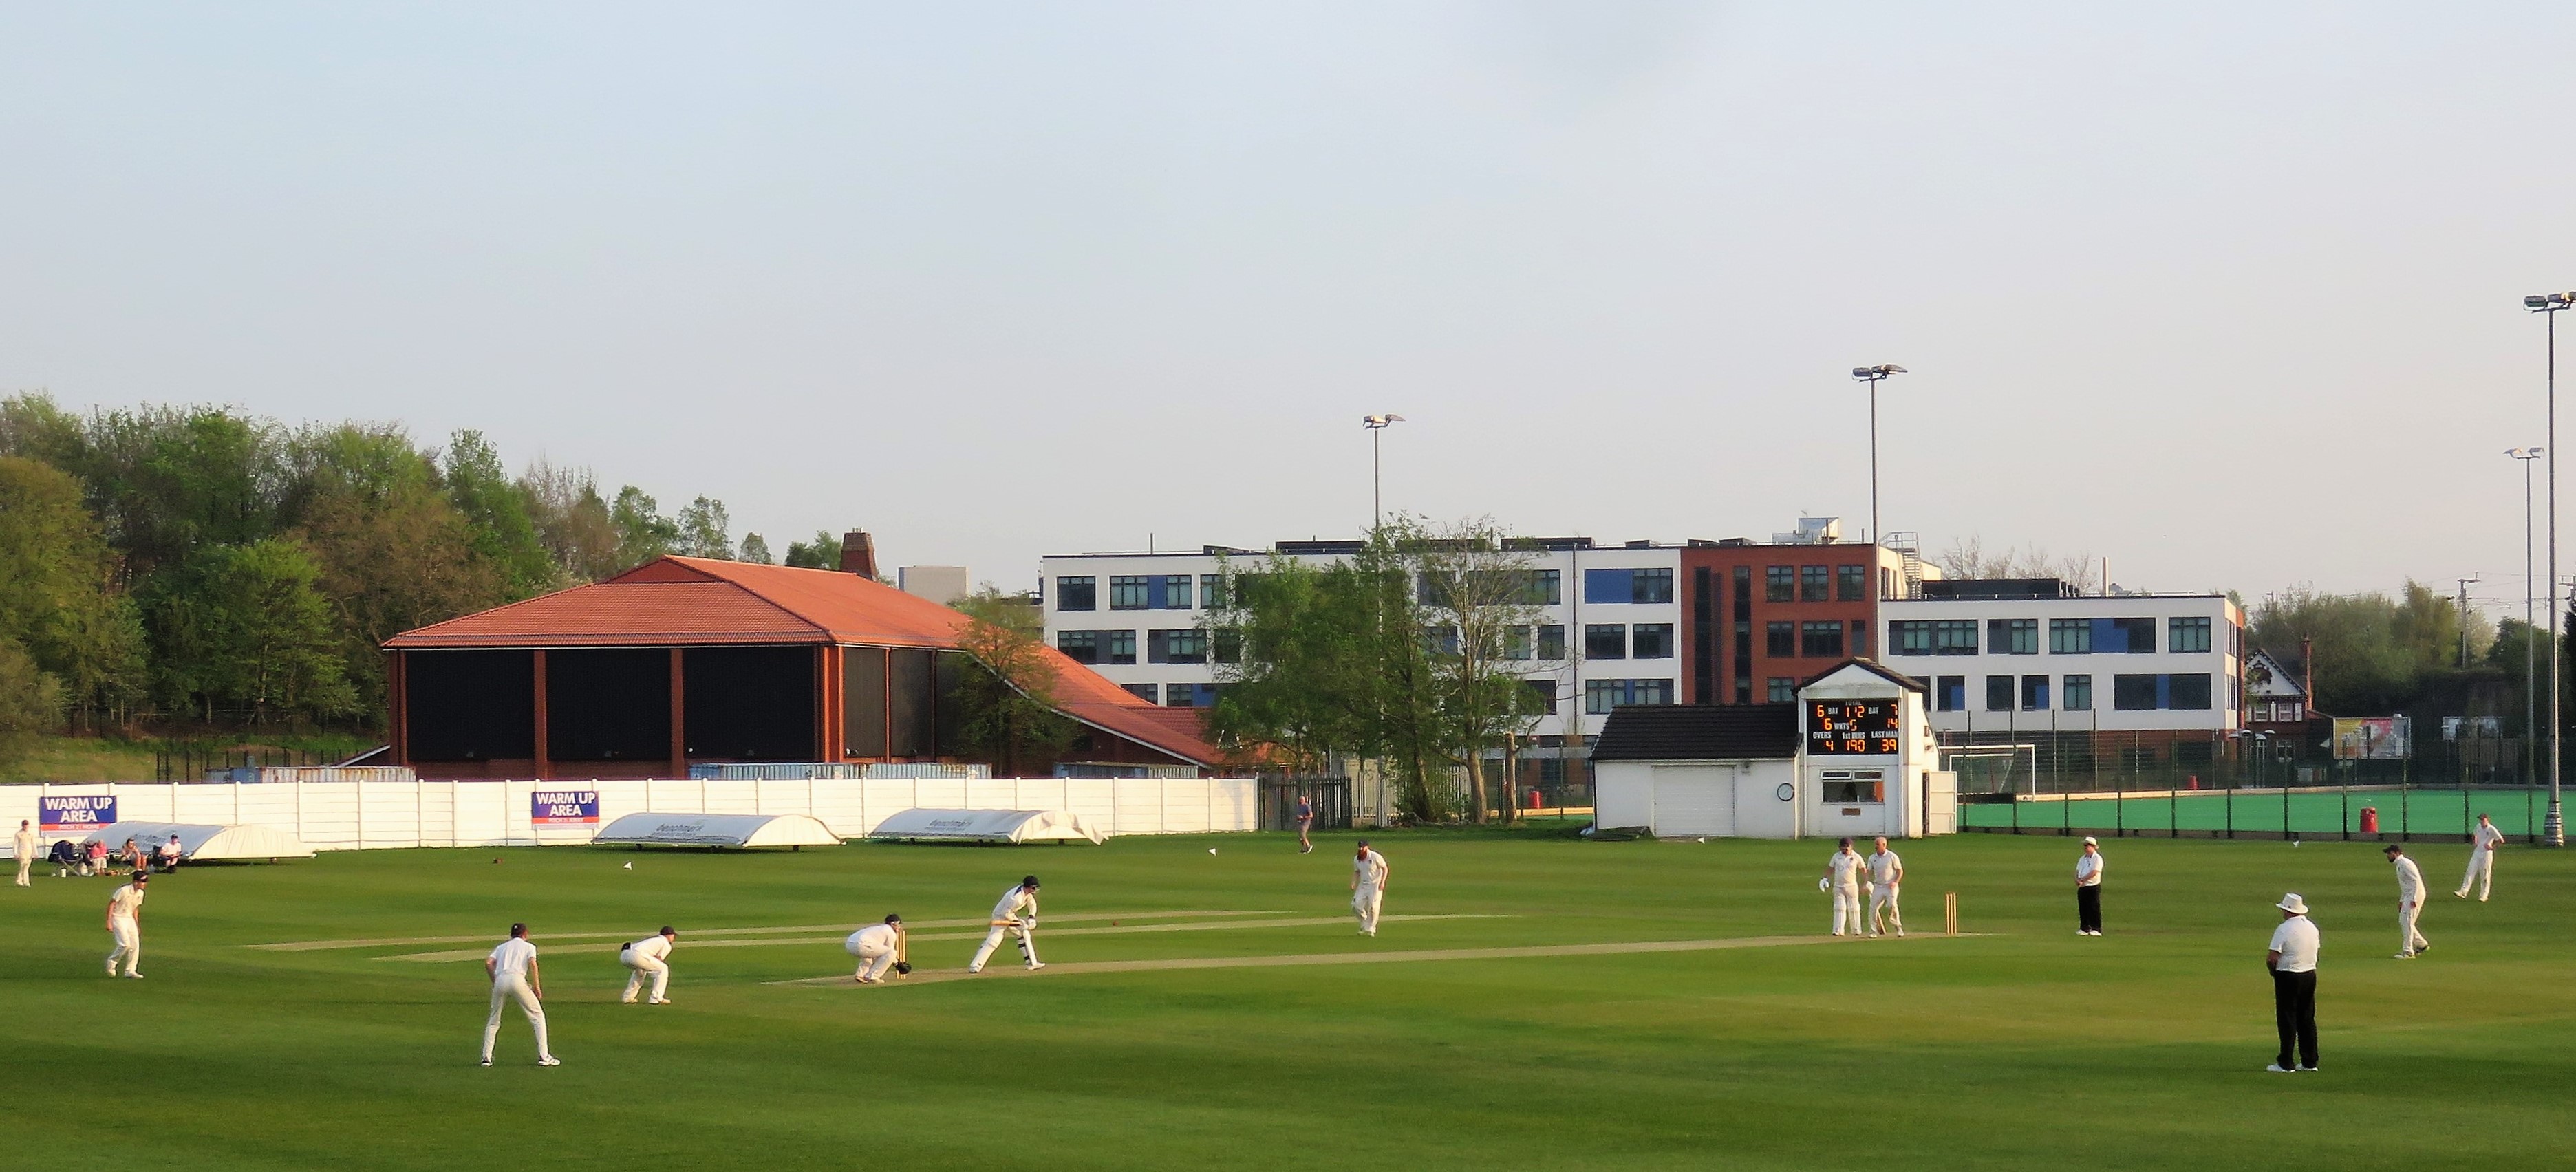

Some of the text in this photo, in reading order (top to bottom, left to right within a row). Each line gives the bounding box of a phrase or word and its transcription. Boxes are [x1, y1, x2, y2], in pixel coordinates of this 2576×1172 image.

[1817, 705, 1825, 717] 6
[1891, 704, 1898, 715] 7
[1824, 718, 1832, 730] 6
[1887, 718, 1898, 728] 14
[1825, 740, 1834, 751] 4
[1847, 739, 1865, 752] 190
[1882, 739, 1897, 752] 39
[45, 797, 113, 810] WARM UP
[537, 792, 596, 805] WARM UP
[60, 810, 98, 823] AREA
[549, 805, 583, 816] AREA
